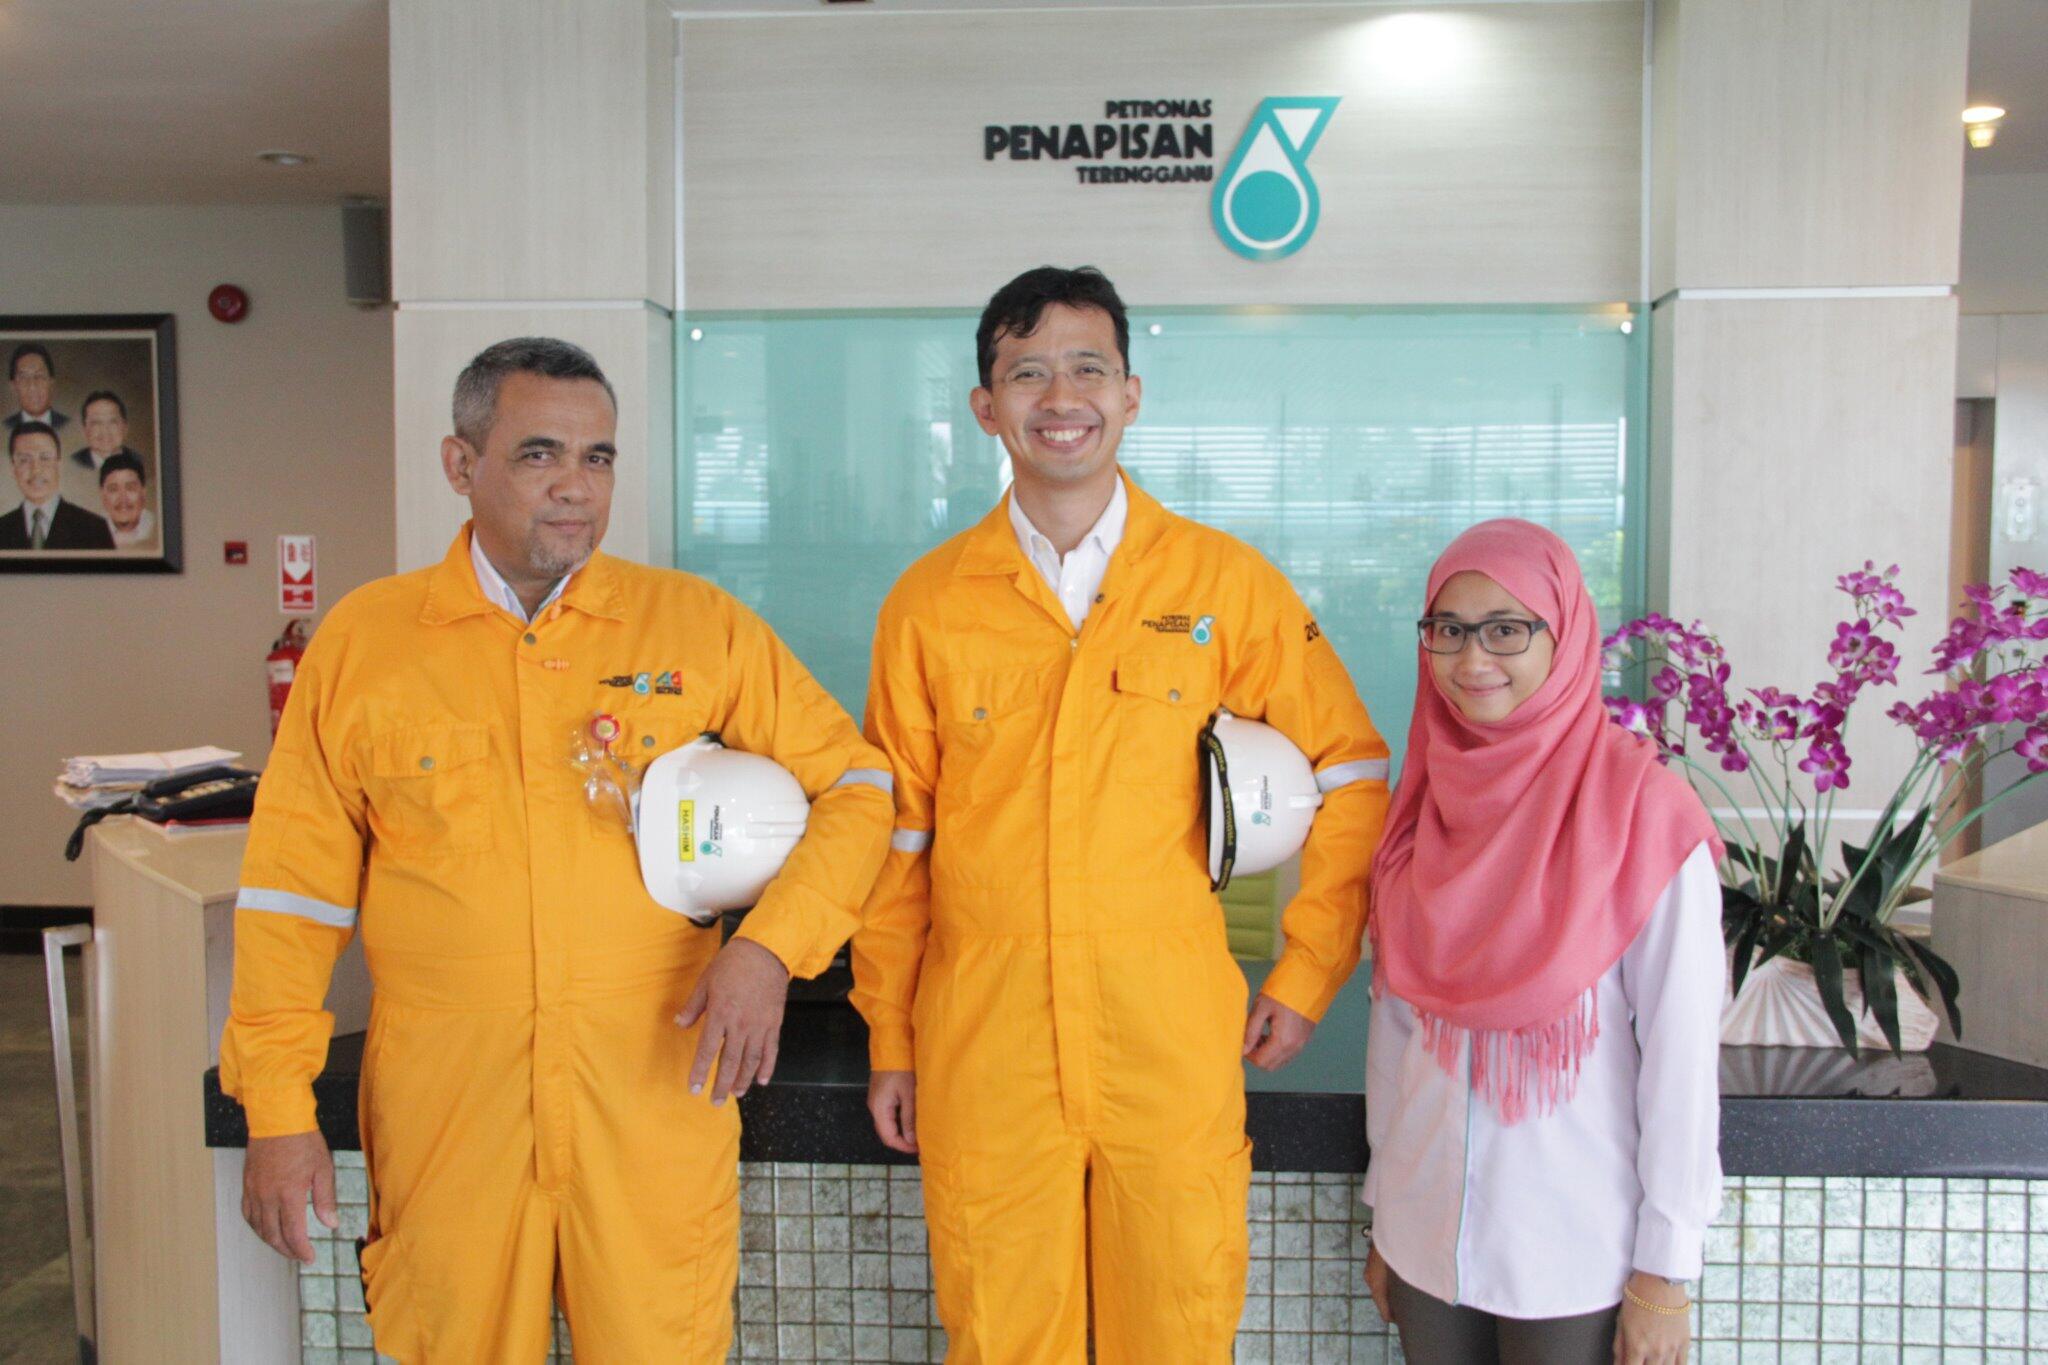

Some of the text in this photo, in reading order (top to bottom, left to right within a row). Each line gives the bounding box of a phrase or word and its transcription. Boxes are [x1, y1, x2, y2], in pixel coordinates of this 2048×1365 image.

[1105, 99, 1212, 118] PETRONAS
[984, 123, 1213, 160] PENAPISAN
[1076, 165, 1213, 184] TERENGGANU
[682, 809, 690, 852] HASHIM
